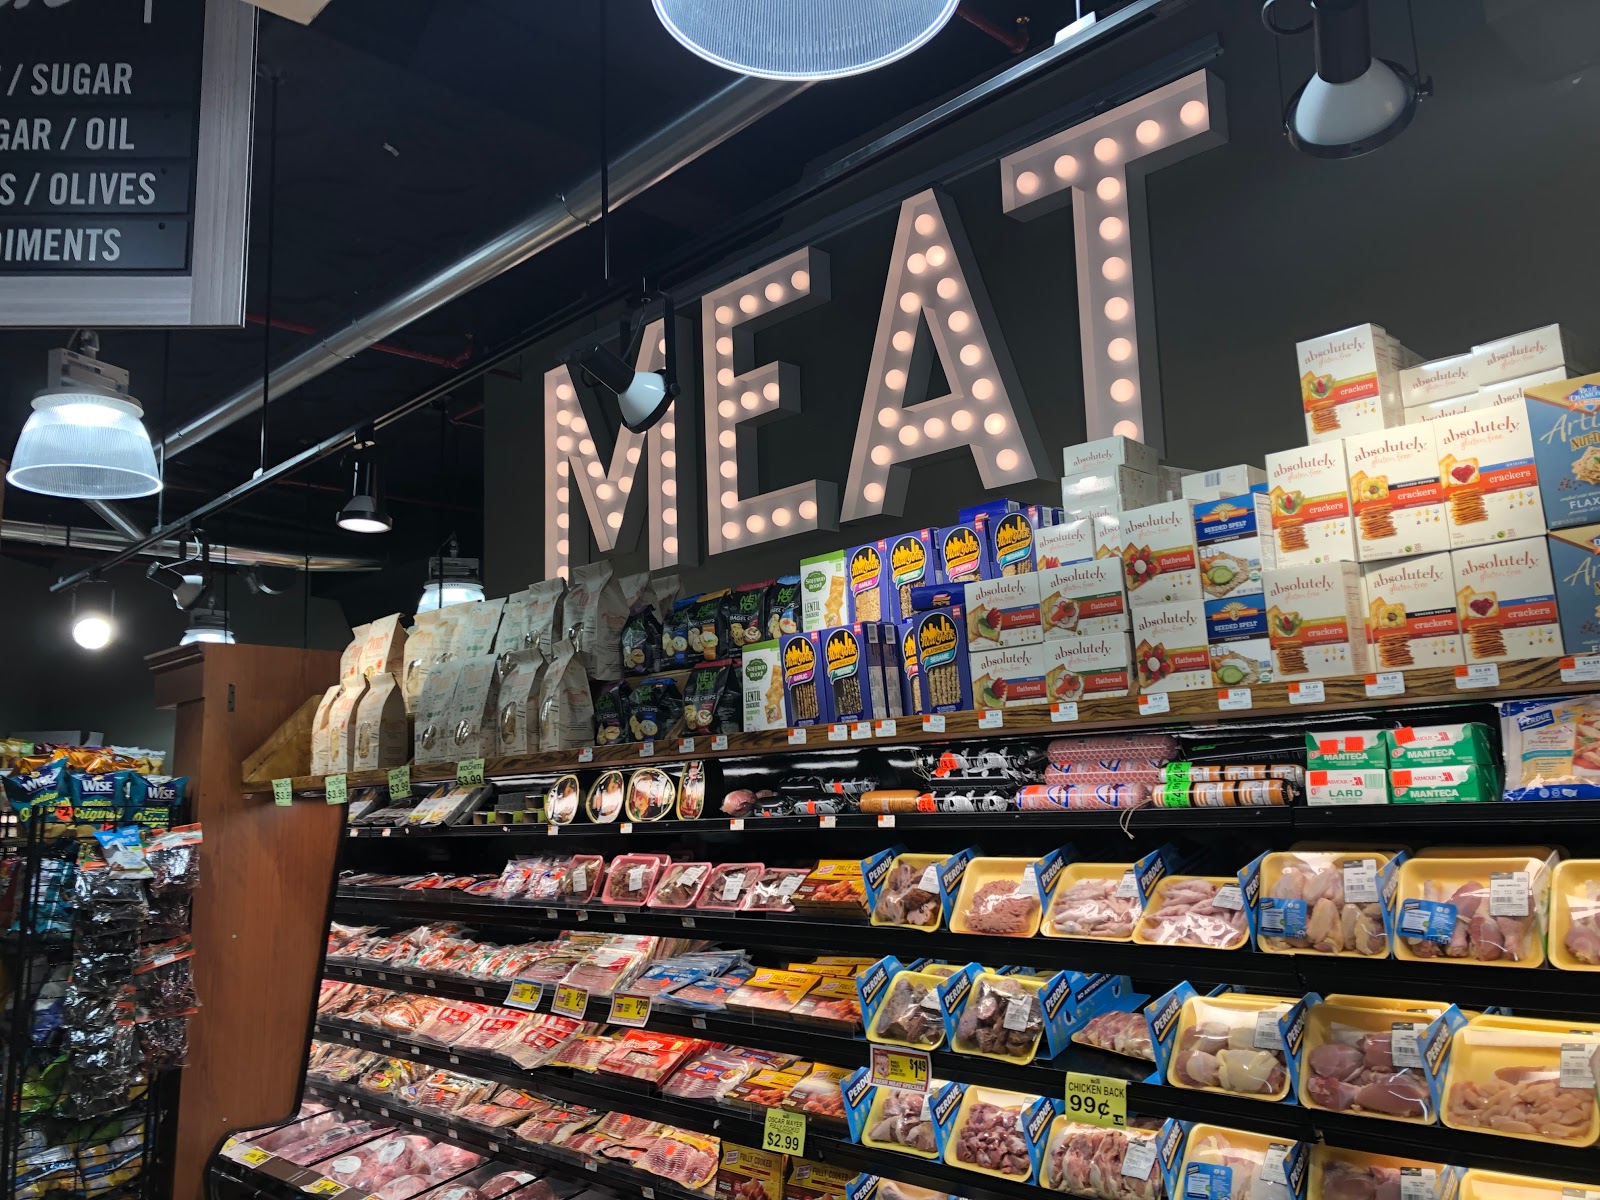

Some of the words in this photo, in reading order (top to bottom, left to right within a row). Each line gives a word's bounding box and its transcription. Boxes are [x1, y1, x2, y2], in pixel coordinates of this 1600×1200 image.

[31, 63, 133, 95] SUGAR
[86, 117, 135, 150] OIL
[49, 172, 156, 206] OLIVES
[0, 228, 122, 262] IMENTS
[544, 68, 1217, 583] MEAT
[1304, 336, 1366, 365] absolutely
[1486, 340, 1548, 366] absolutely
[1412, 367, 1469, 390] absolutely
[1340, 383, 1374, 395] crackers
[1493, 388, 1524, 407] absol
[1443, 416, 1520, 445] absolutely
[1539, 411, 1600, 444] Arti
[1487, 433, 1503, 443] free
[1354, 436, 1428, 462] absolutely
[1397, 452, 1413, 461] free
[1073, 449, 1114, 467] absolutely
[1273, 453, 1336, 478] absolutely
[1489, 470, 1531, 483] crackers
[1397, 487, 1438, 501] crackers
[1309, 501, 1344, 514] crackers
[1570, 496, 1600, 509] FLAX
[1125, 511, 1182, 535] absolutely
[1204, 523, 1228, 534] SEEDED
[1228, 520, 1248, 530] SPELT
[1039, 529, 1086, 549] absolutely
[1006, 551, 1026, 561] SESAME
[1161, 554, 1191, 566] flatbread
[1461, 551, 1539, 576] absolutely
[955, 563, 973, 572] POPPY
[858, 580, 873, 589] GARLIC
[1050, 565, 1107, 588] absolutely
[1373, 565, 1443, 589] absolutely
[975, 580, 1026, 601] absolutely
[1270, 575, 1334, 597] absolutely
[1413, 581, 1428, 590] free
[805, 600, 820, 613] LENTIL
[1091, 600, 1118, 611] flatbread
[1508, 607, 1551, 618] crackers
[1011, 612, 1036, 622] flatbread
[1138, 610, 1198, 631] absolutely
[1414, 618, 1453, 630] crackers
[1214, 623, 1238, 632] SEEDED
[1239, 621, 1258, 629] SPELT
[1308, 627, 1343, 637] crackers
[930, 652, 950, 663] SESAME
[1054, 640, 1112, 661] absolutely
[981, 651, 1032, 670] absolutely
[1174, 655, 1205, 665] flatbread
[793, 672, 808, 682] GARLIC
[1095, 676, 1123, 685] flatbread
[745, 691, 761, 703] LENTIL
[1016, 685, 1041, 693] flatbread
[1520, 712, 1551, 726] PERDUE
[1323, 752, 1368, 761] MANTECA
[1407, 749, 1456, 759] MANTECA
[82, 779, 114, 792] WISE
[390, 781, 410, 795] $3.99
[457, 774, 482, 787] $3.99
[148, 786, 175, 800] WISE
[326, 790, 346, 800] $3.99
[1329, 789, 1363, 797] LARD
[1410, 788, 1459, 798] MANTECA
[868, 855, 894, 883] PERDUE
[943, 857, 968, 887] PERDUE
[1040, 857, 1066, 887] PERDUE
[1141, 858, 1164, 889] PERDUE
[772, 973, 785, 982] FULLY
[785, 974, 808, 984] COOKED
[862, 964, 888, 999] PERDUE
[945, 971, 970, 1007] PERDUE
[1045, 978, 1069, 1013] PERDUE
[1153, 998, 1181, 1035] PERDUE
[848, 1071, 870, 1101] PERDU
[1068, 1081, 1102, 1095] CHICKEN
[1103, 1086, 1125, 1098] BACK
[935, 1086, 961, 1119] PERDUE
[1070, 1094, 1110, 1119] 99¢
[768, 1116, 786, 1125] OSCAR
[786, 1118, 803, 1128] MAYER
[1028, 1099, 1053, 1138] PERDUE
[769, 1122, 781, 1131] FULLY
[781, 1125, 800, 1133] COOKED
[767, 1131, 799, 1151] $2.99
[1162, 1120, 1181, 1163] PERDUE
[740, 1152, 754, 1164] FULLY
[754, 1156, 773, 1168] COOKED
